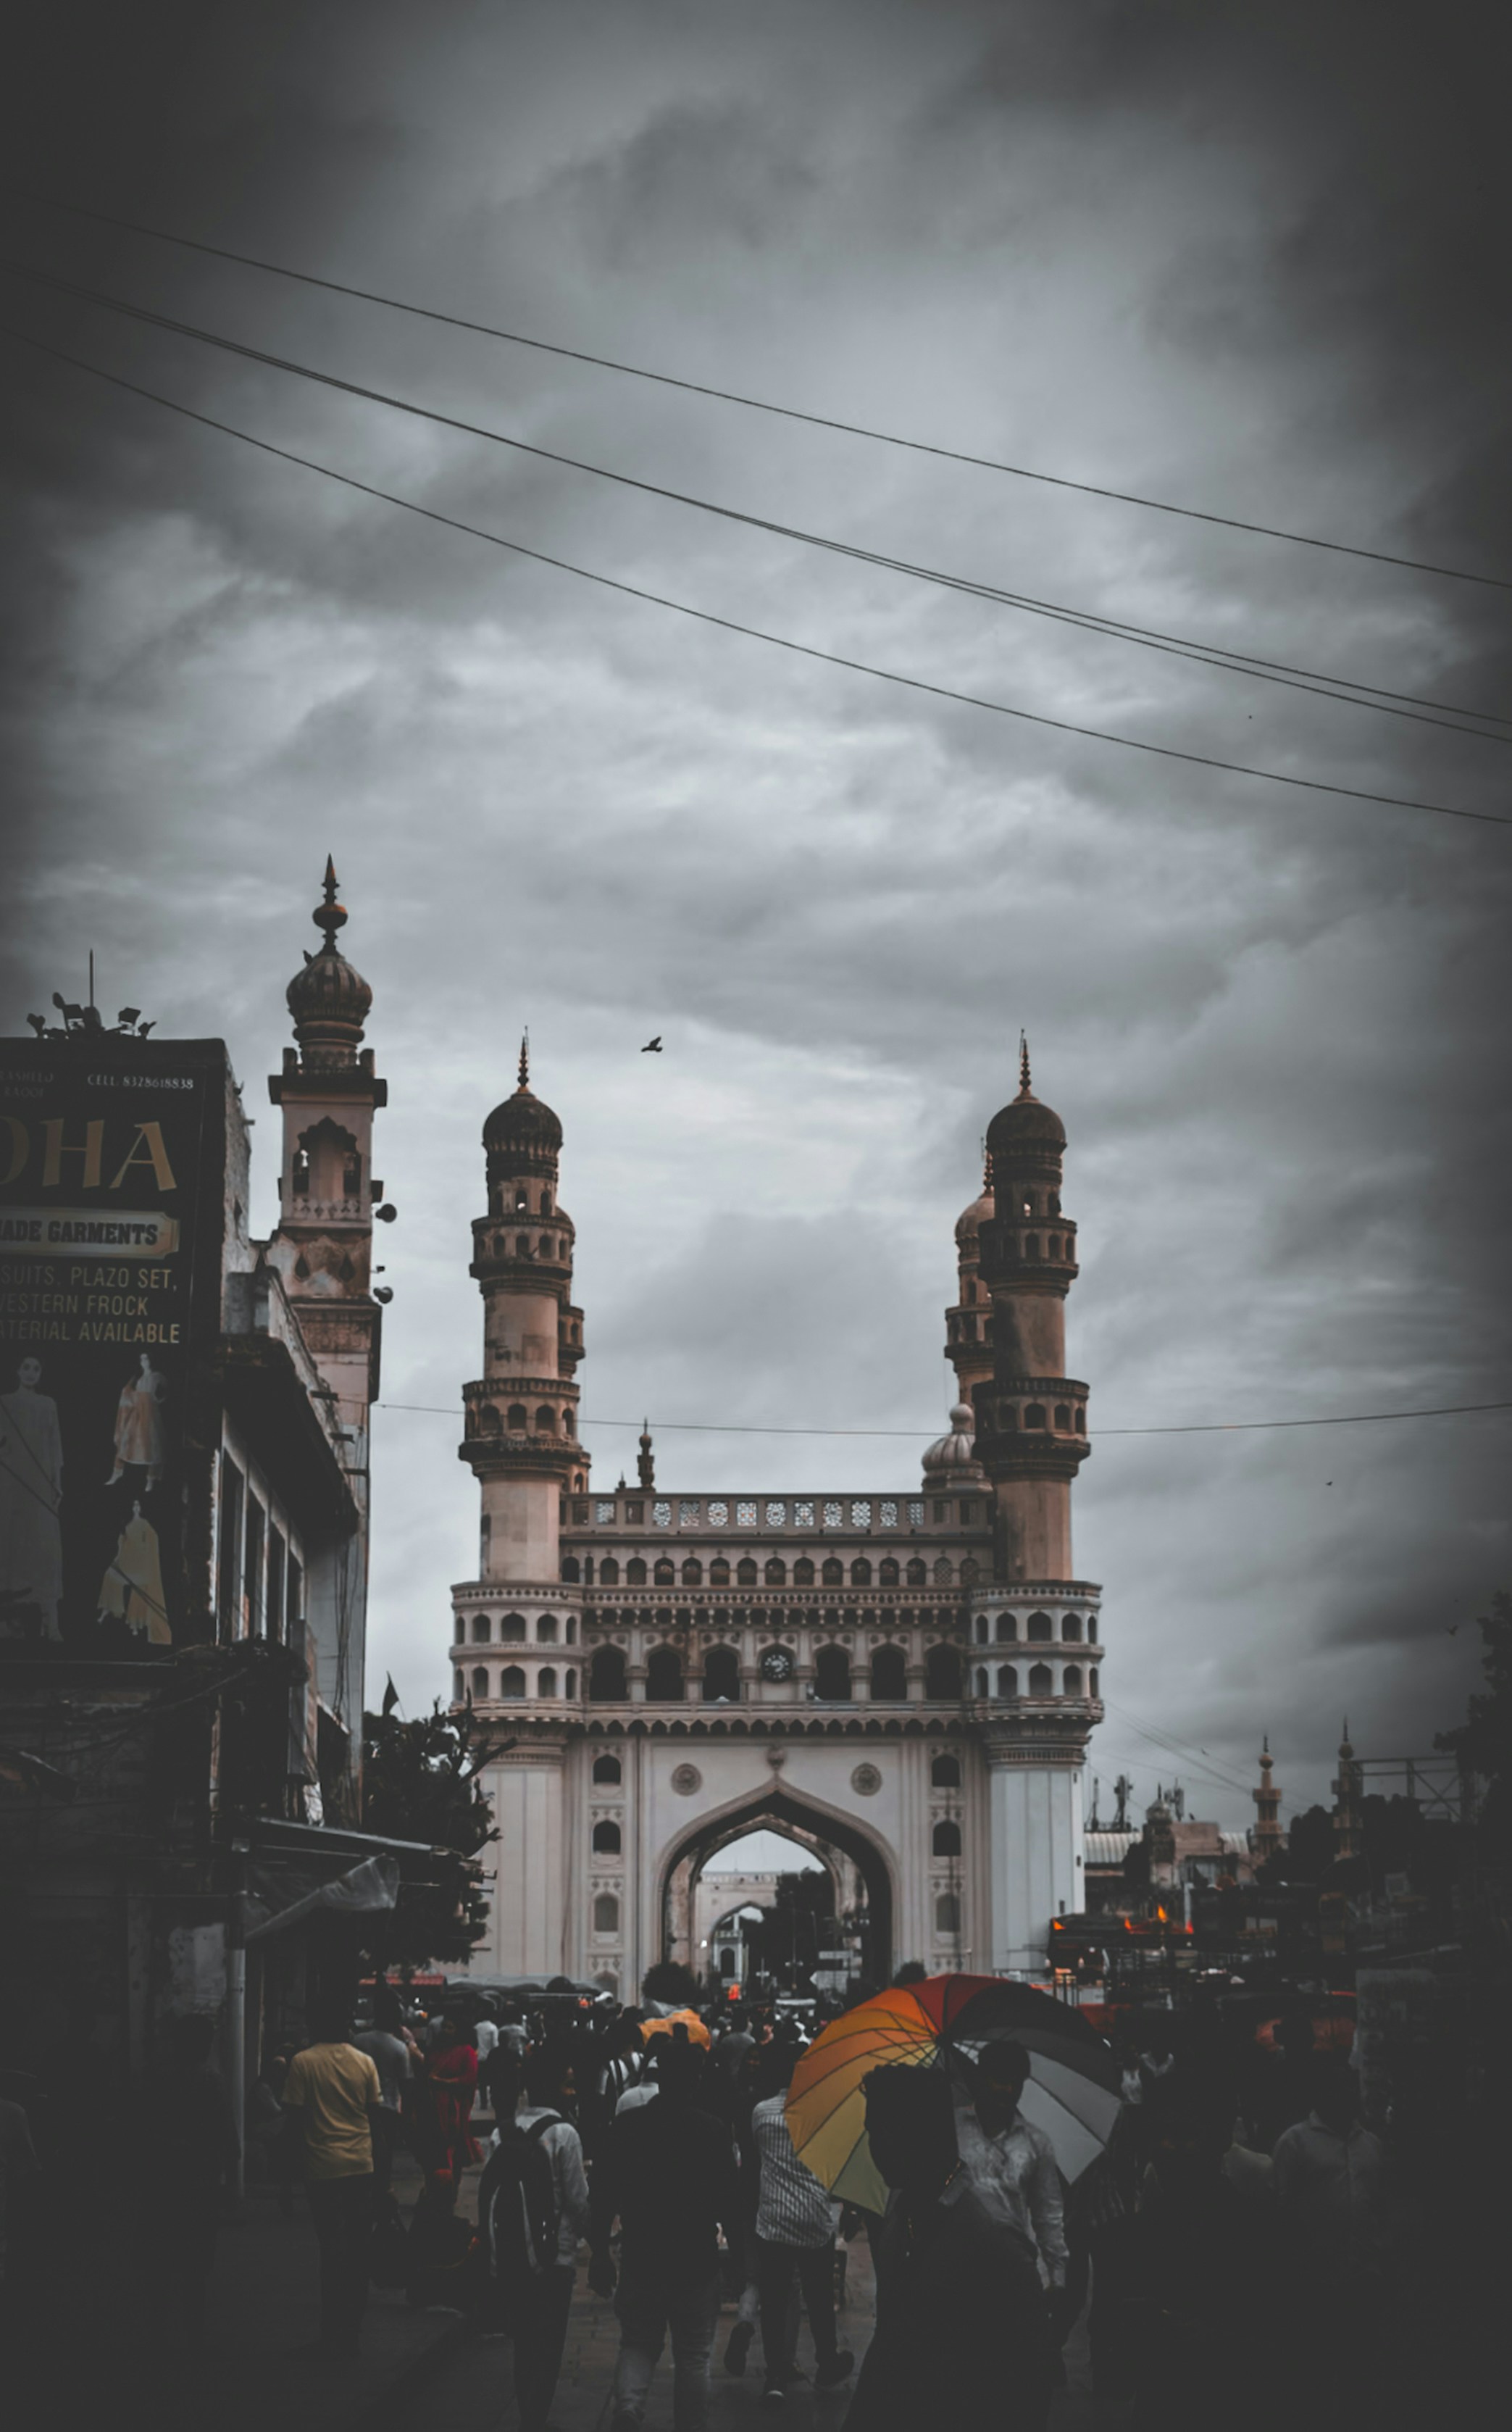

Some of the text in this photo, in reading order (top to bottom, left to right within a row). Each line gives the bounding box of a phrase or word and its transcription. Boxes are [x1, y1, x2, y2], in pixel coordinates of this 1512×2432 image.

[0, 1220, 159, 1246] ADE GARMENTS
[71, 1266, 129, 1288] PLAZO
[138, 1267, 178, 1293] SET,
[86, 1294, 149, 1316] FROCK
[78, 1322, 182, 1344] AVAILABLE
